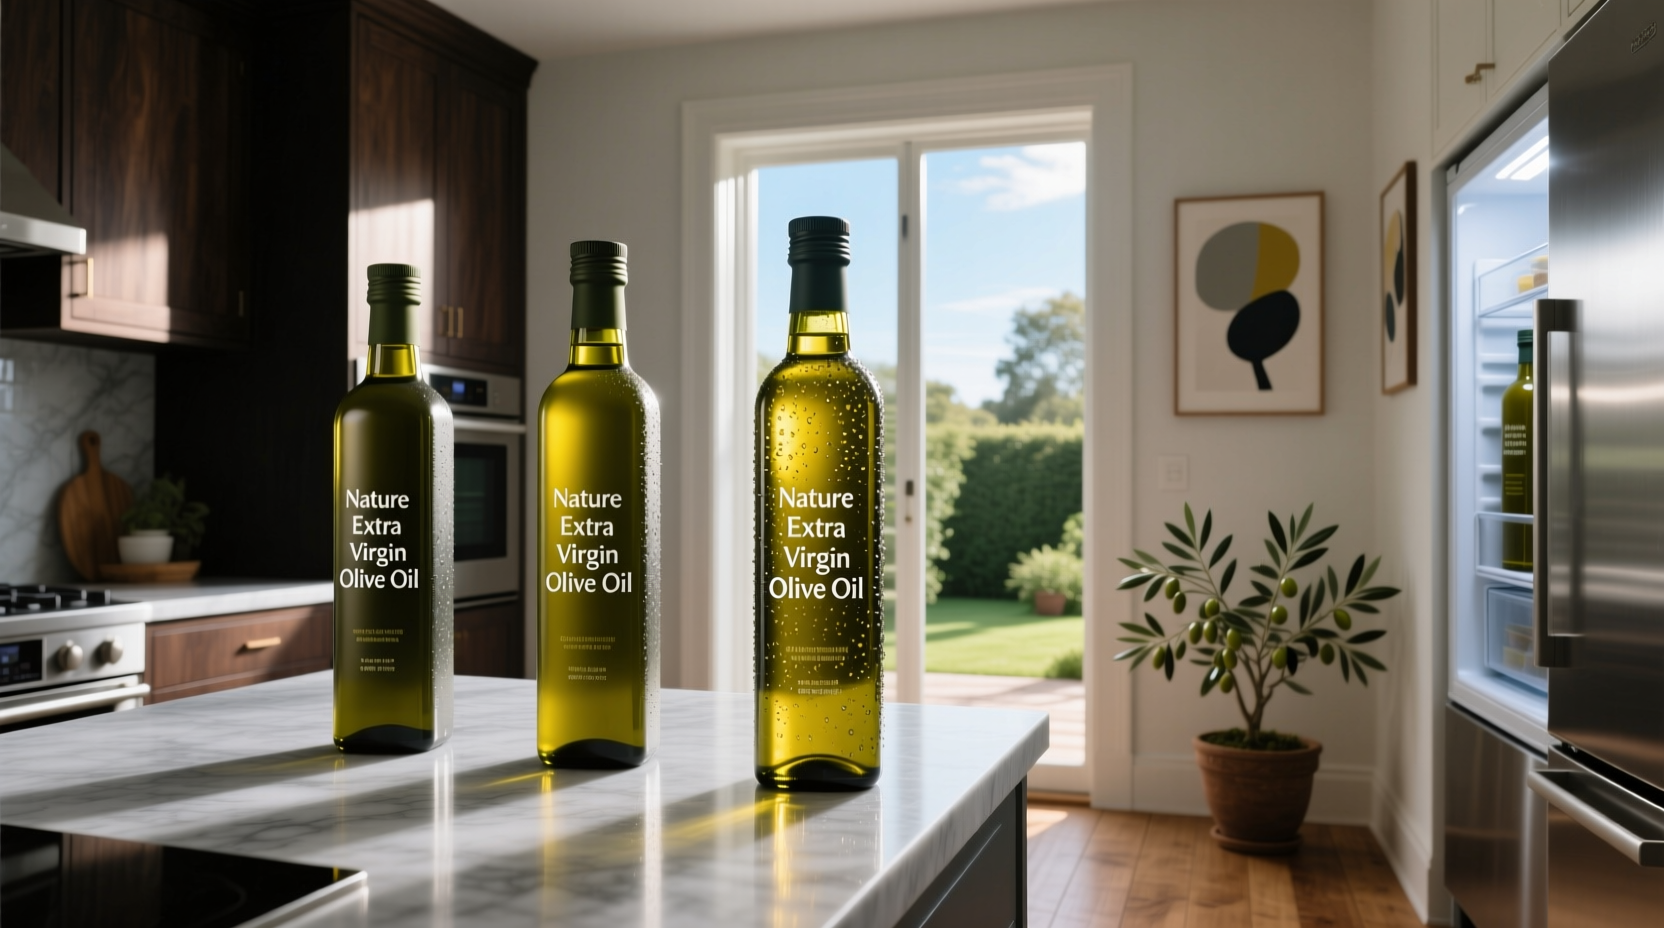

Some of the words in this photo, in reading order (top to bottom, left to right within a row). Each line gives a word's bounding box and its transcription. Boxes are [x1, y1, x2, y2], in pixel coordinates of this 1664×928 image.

[346, 488, 409, 508] Nature
[554, 488, 621, 508] Nature
[780, 487, 853, 508] Nature
[353, 515, 401, 535] Extra
[561, 516, 613, 536] Extra
[788, 516, 845, 538] Extra
[349, 542, 406, 567] Virgin
[557, 544, 618, 570] Virgin
[784, 546, 849, 575] Virgin
[340, 568, 385, 588] Olive
[391, 569, 418, 588] Oil
[546, 572, 596, 592] Olive
[602, 572, 631, 593] Oil
[769, 577, 826, 599] Olive
[832, 577, 863, 599] Oil
